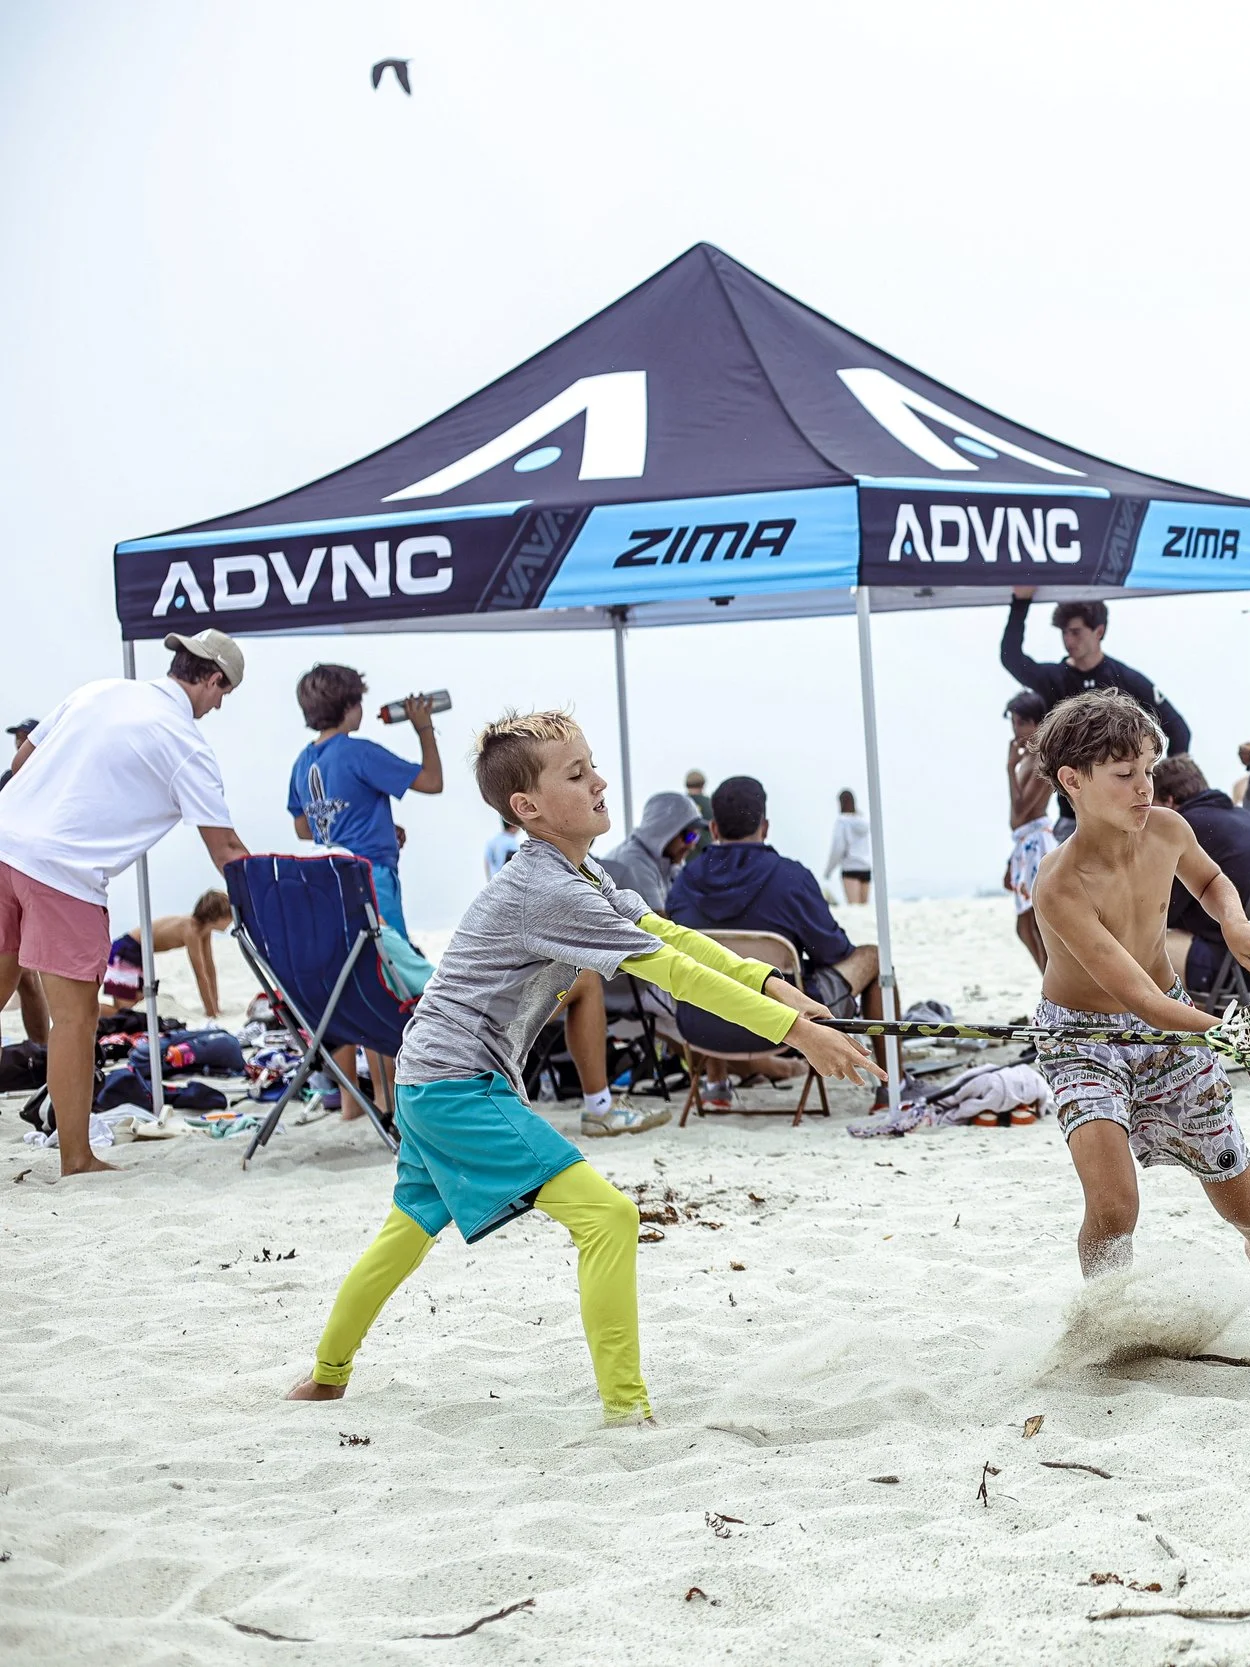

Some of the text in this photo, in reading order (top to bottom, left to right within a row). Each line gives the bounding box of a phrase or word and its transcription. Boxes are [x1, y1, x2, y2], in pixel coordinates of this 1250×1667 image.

[612, 519, 797, 569] ZIMA
[888, 503, 1082, 564] ADVNC
[1161, 525, 1241, 560] ZIMA
[152, 535, 453, 617] ADVNC
